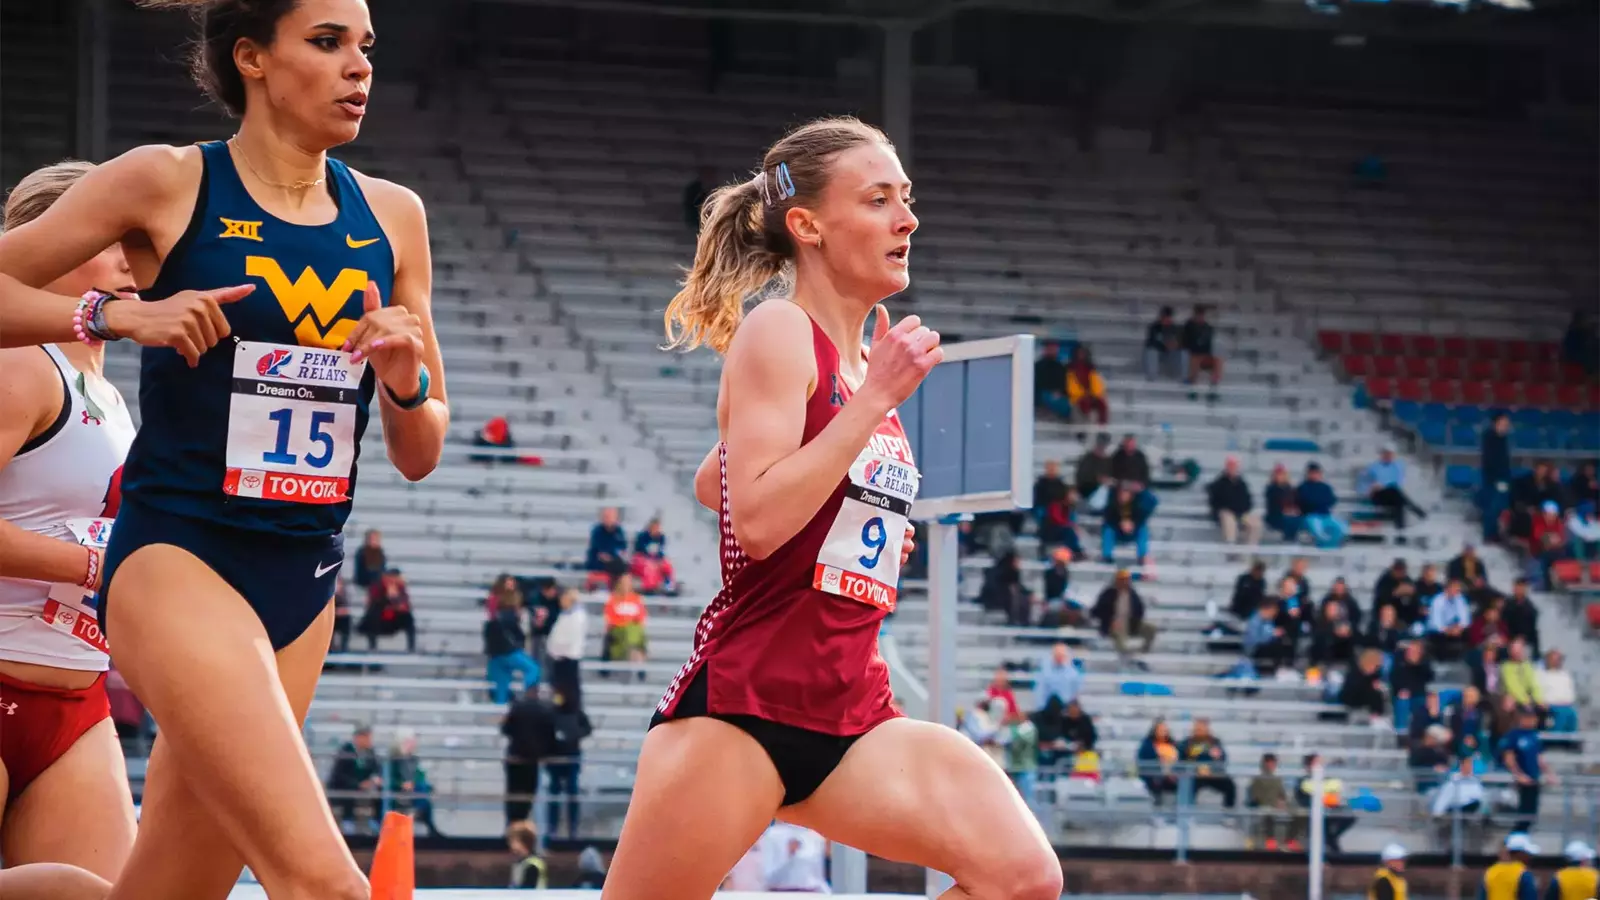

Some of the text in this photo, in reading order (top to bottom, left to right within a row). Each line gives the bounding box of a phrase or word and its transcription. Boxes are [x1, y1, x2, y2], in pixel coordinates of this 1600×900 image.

[219, 217, 264, 242] XII
[301, 352, 341, 367] PENN
[297, 366, 348, 382] RELAYS
[256, 383, 295, 397] Dream
[262, 408, 336, 469] 15
[887, 463, 909, 480] PENN
[269, 475, 338, 499] TOYOTA
[883, 477, 914, 497] RELAYS
[859, 490, 881, 506] Dream
[858, 516, 887, 570] 9
[844, 575, 890, 607] TOYOTA
